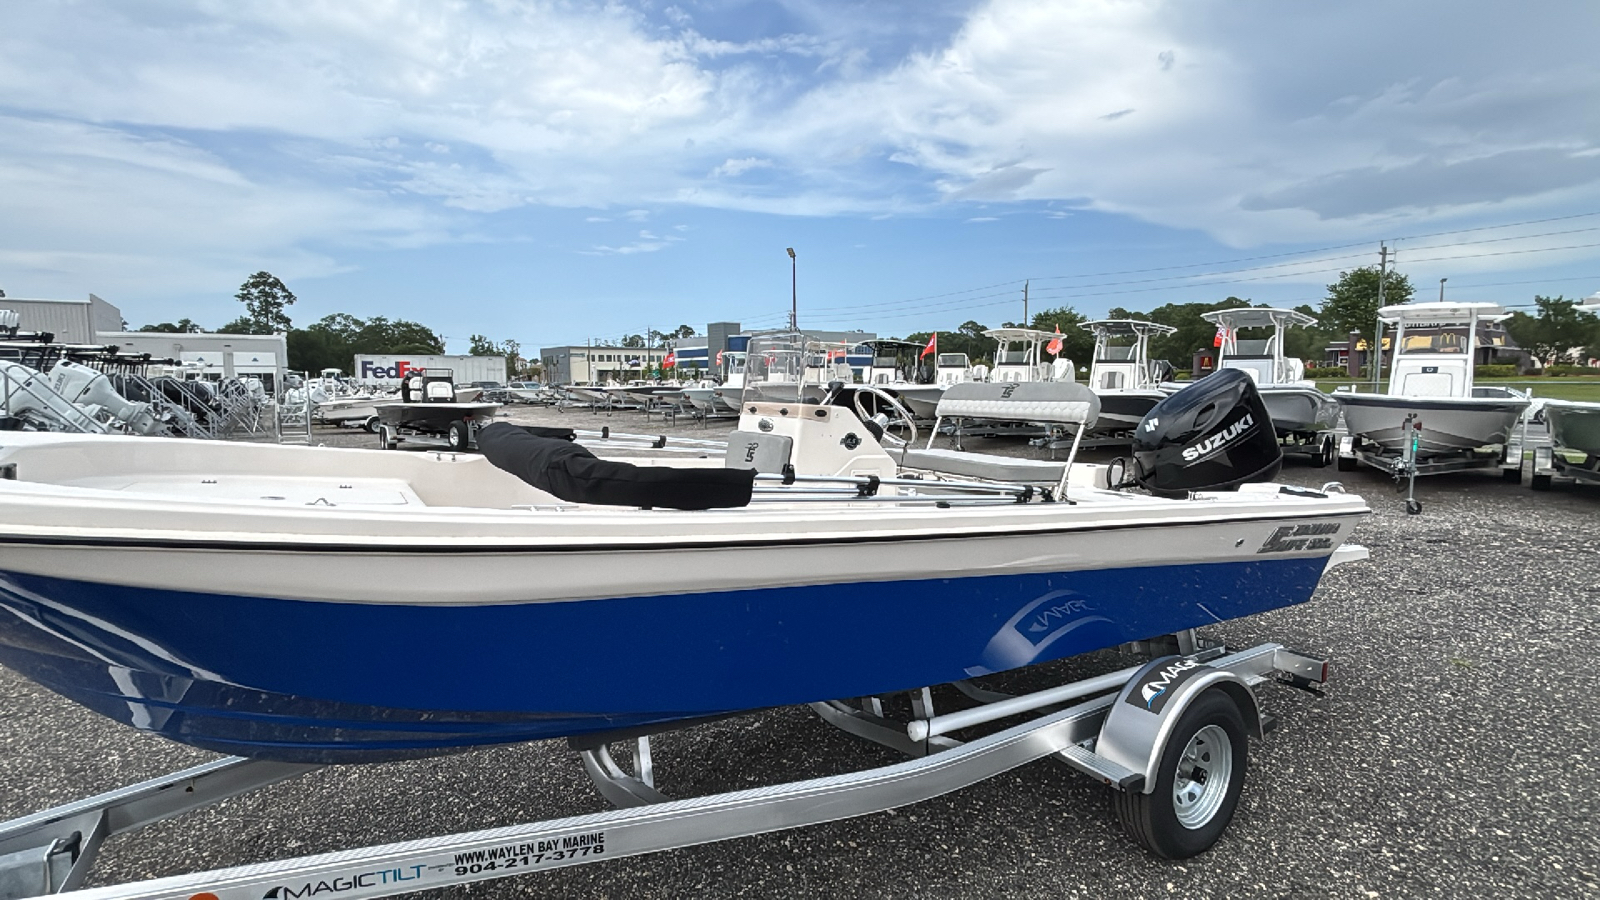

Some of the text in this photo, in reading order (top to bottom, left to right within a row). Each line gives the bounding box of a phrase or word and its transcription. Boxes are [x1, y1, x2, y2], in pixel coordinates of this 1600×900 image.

[1182, 413, 1254, 461] SUZUKI
[1148, 659, 1199, 690] MAG
[454, 832, 605, 866] WWW.WAYLEN BAY MARINE
[455, 844, 605, 876] 904-217-3778
[283, 864, 427, 900] MAGICTILT
